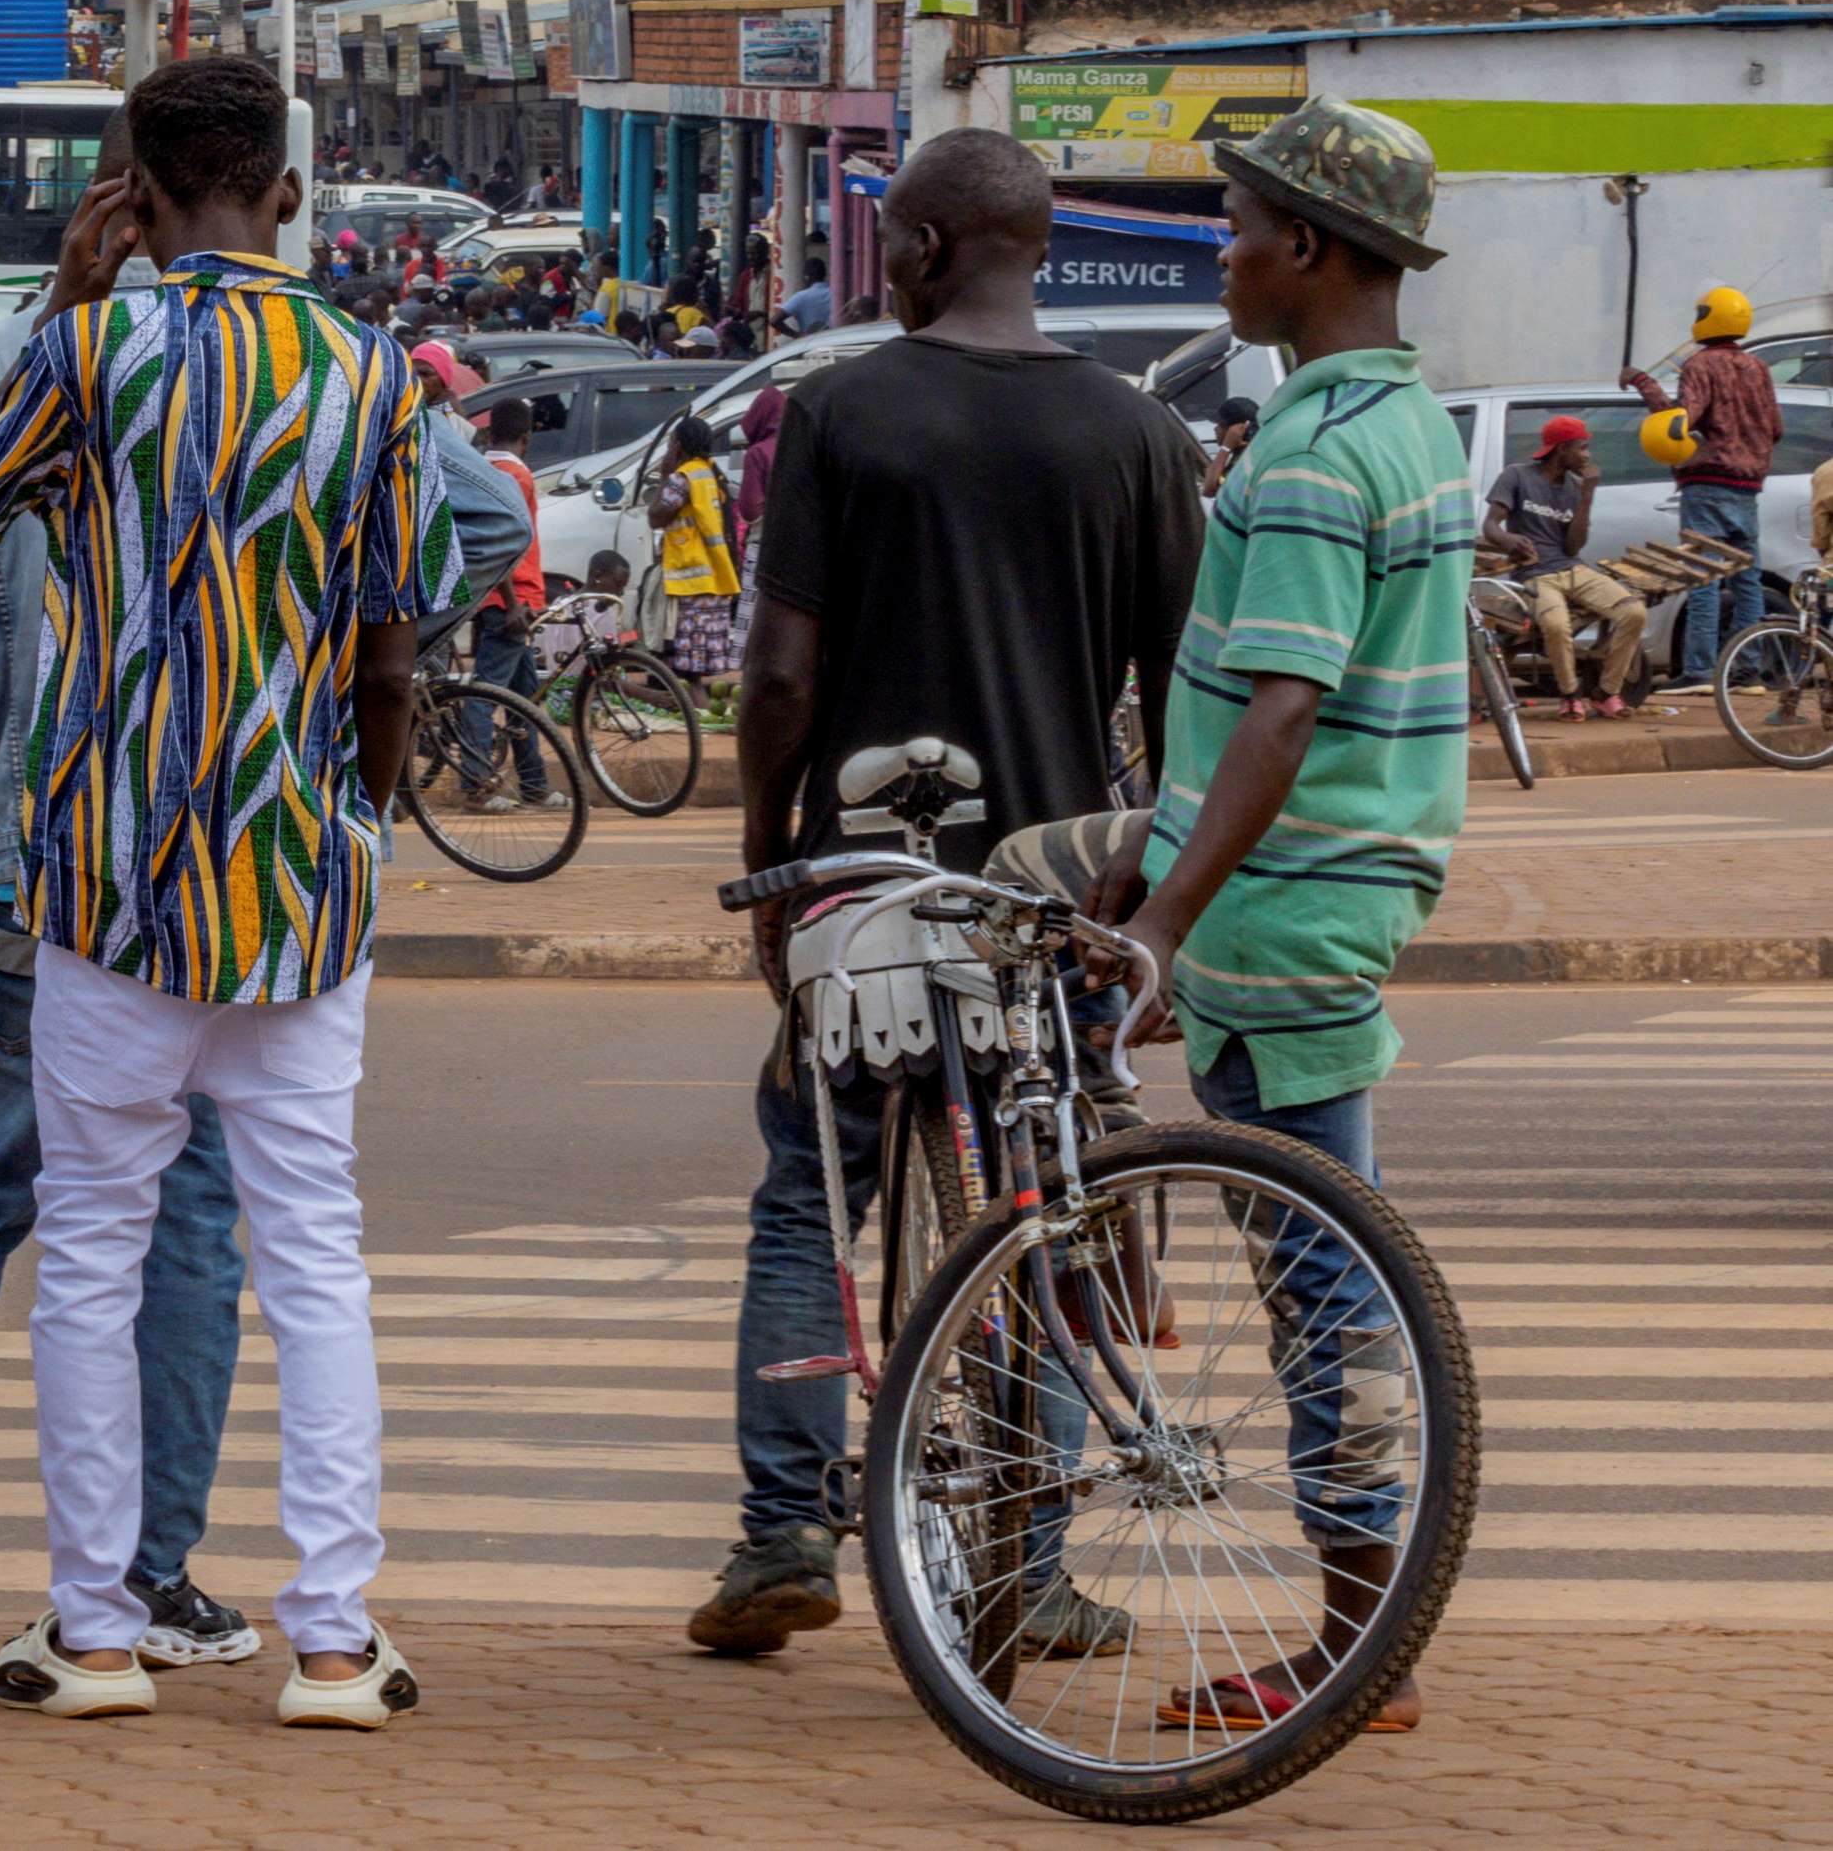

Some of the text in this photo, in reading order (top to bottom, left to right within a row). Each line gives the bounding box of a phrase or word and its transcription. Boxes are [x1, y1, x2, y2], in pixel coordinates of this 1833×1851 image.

[1016, 68, 1149, 85] Mama Ganza
[1016, 86, 1073, 95] CHRISTINE
[1061, 260, 1185, 288] SERVICE
